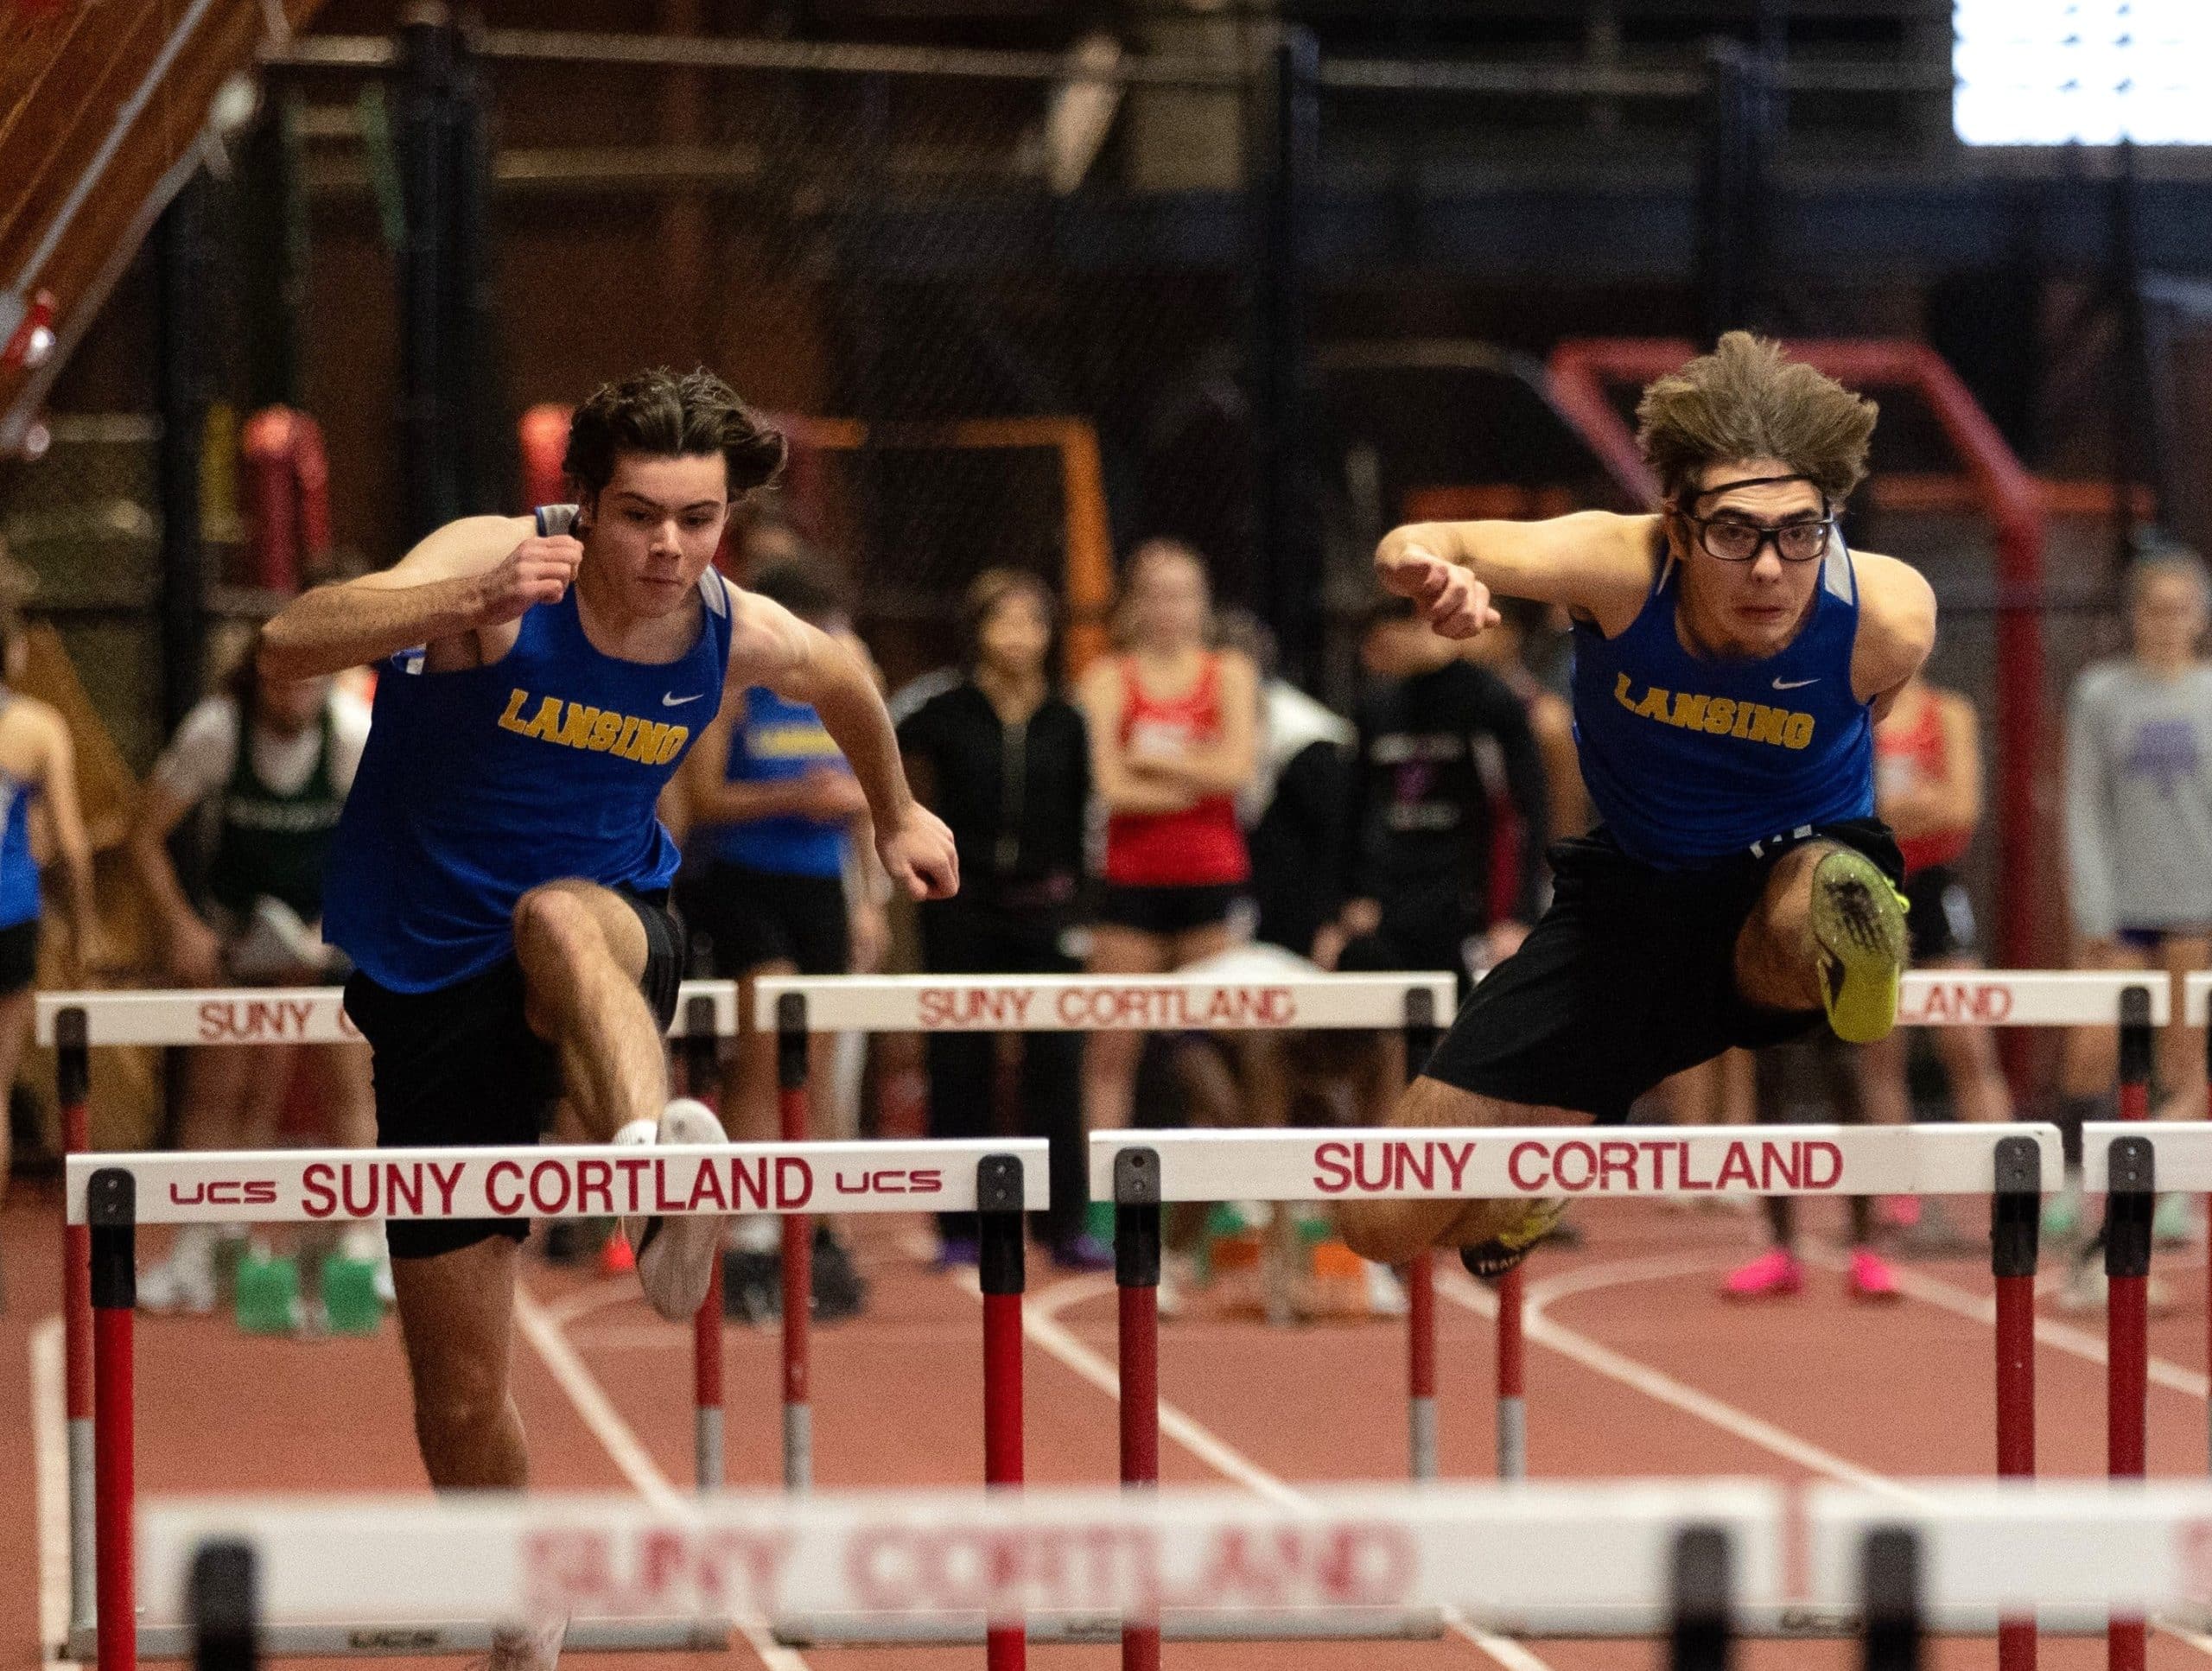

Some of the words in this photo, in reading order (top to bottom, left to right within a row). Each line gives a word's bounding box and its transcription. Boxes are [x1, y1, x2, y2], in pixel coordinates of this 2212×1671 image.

[498, 688, 689, 765] LANSING
[1614, 671, 1815, 750] LANSING
[198, 1001, 315, 1041] SUNY
[918, 988, 1036, 1026] SUNY
[1056, 988, 1296, 1026] CORTLAND
[1897, 983, 2012, 1022] LAND
[169, 1181, 277, 1204] UCS
[302, 1162, 466, 1217] SUNY
[485, 1157, 814, 1216] CORTLAND
[836, 1169, 944, 1194] UCS
[1313, 1140, 1476, 1192] SUNY
[1508, 1139, 1843, 1191] CORTLAND
